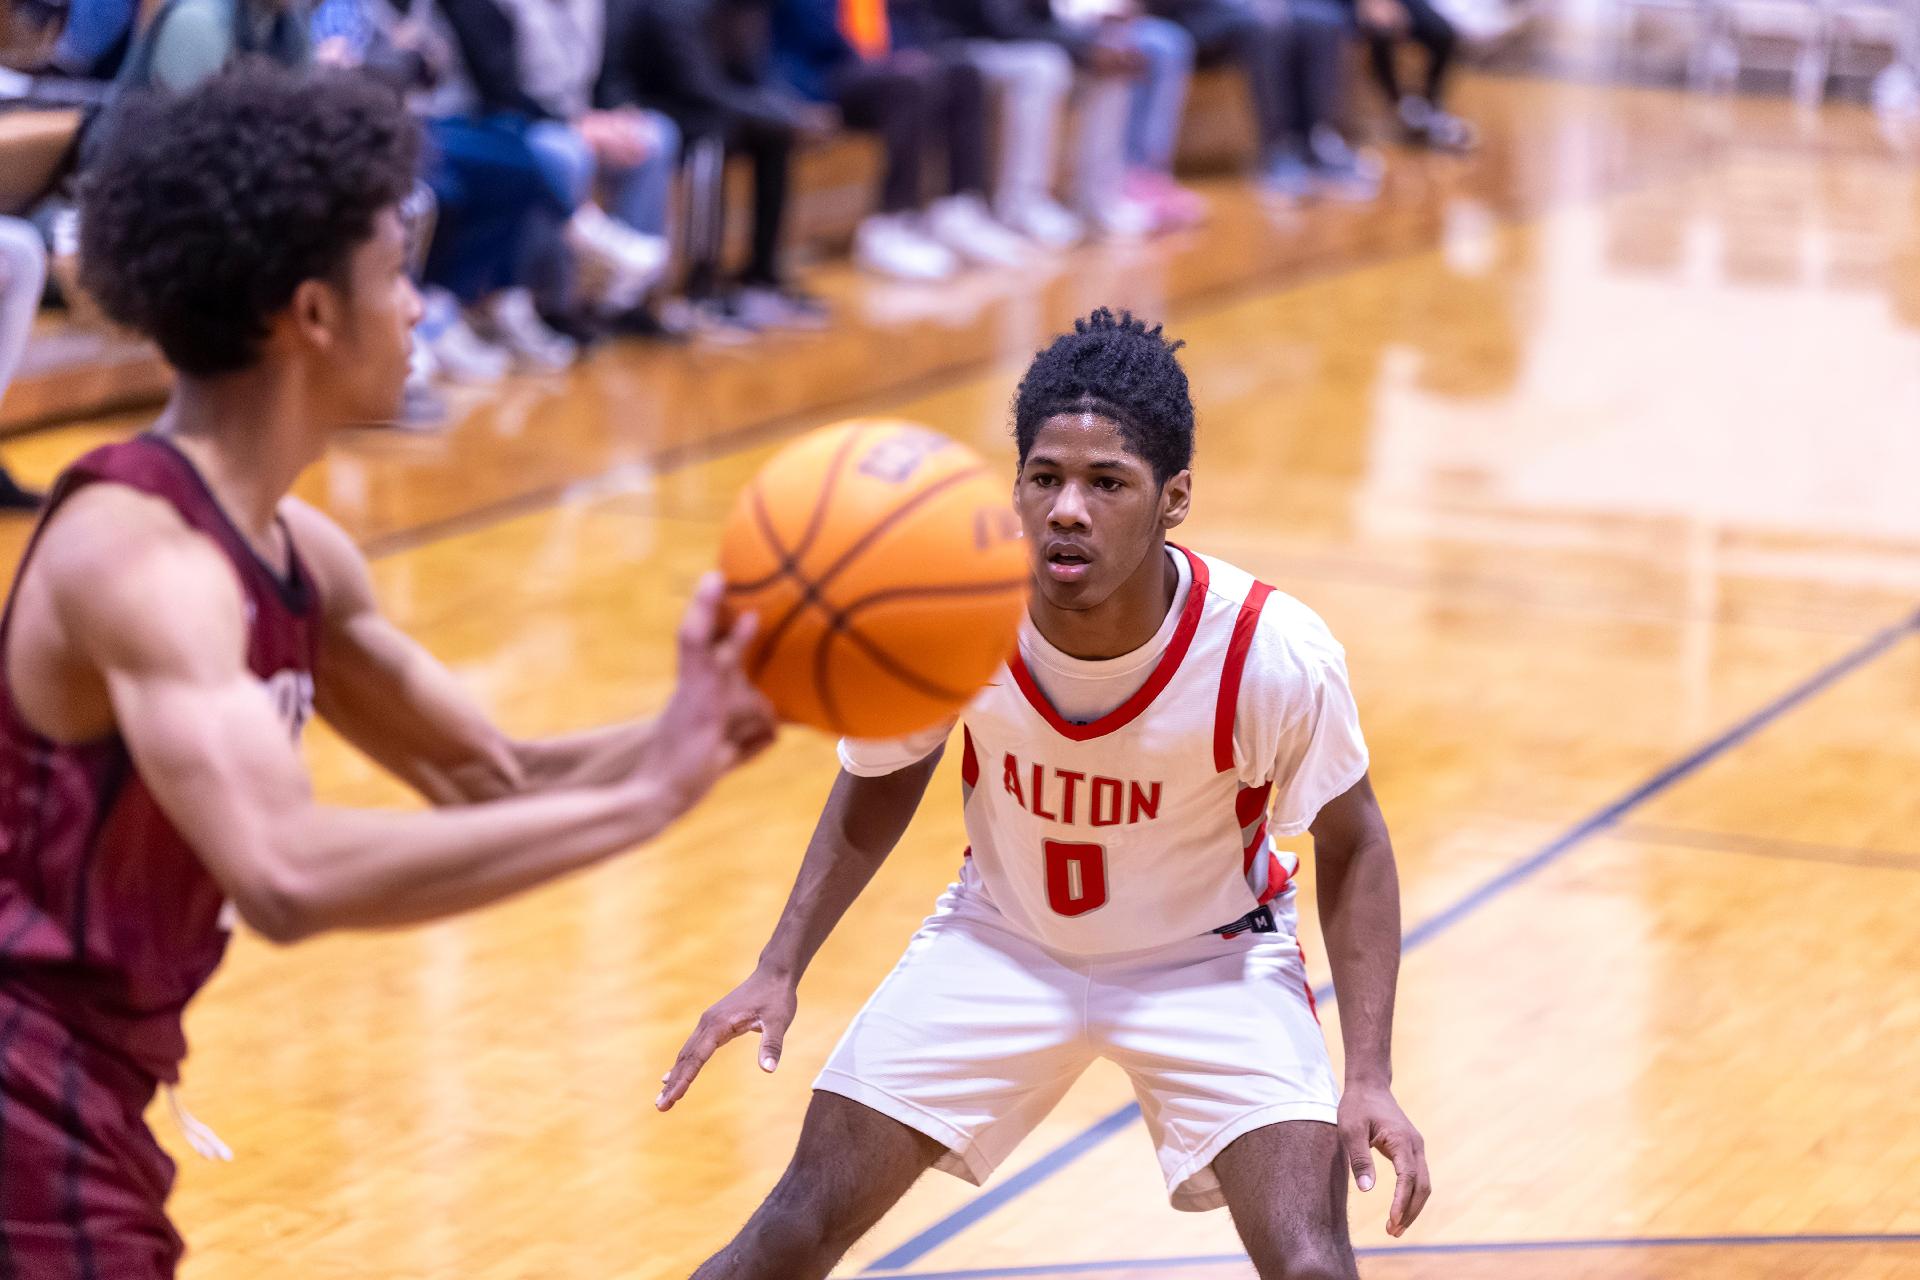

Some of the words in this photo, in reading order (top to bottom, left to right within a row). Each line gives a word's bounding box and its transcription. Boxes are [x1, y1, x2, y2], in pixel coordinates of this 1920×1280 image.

[1003, 751, 1163, 827] ALTON
[1042, 837, 1109, 918] 0
[1254, 915, 1268, 929] M
